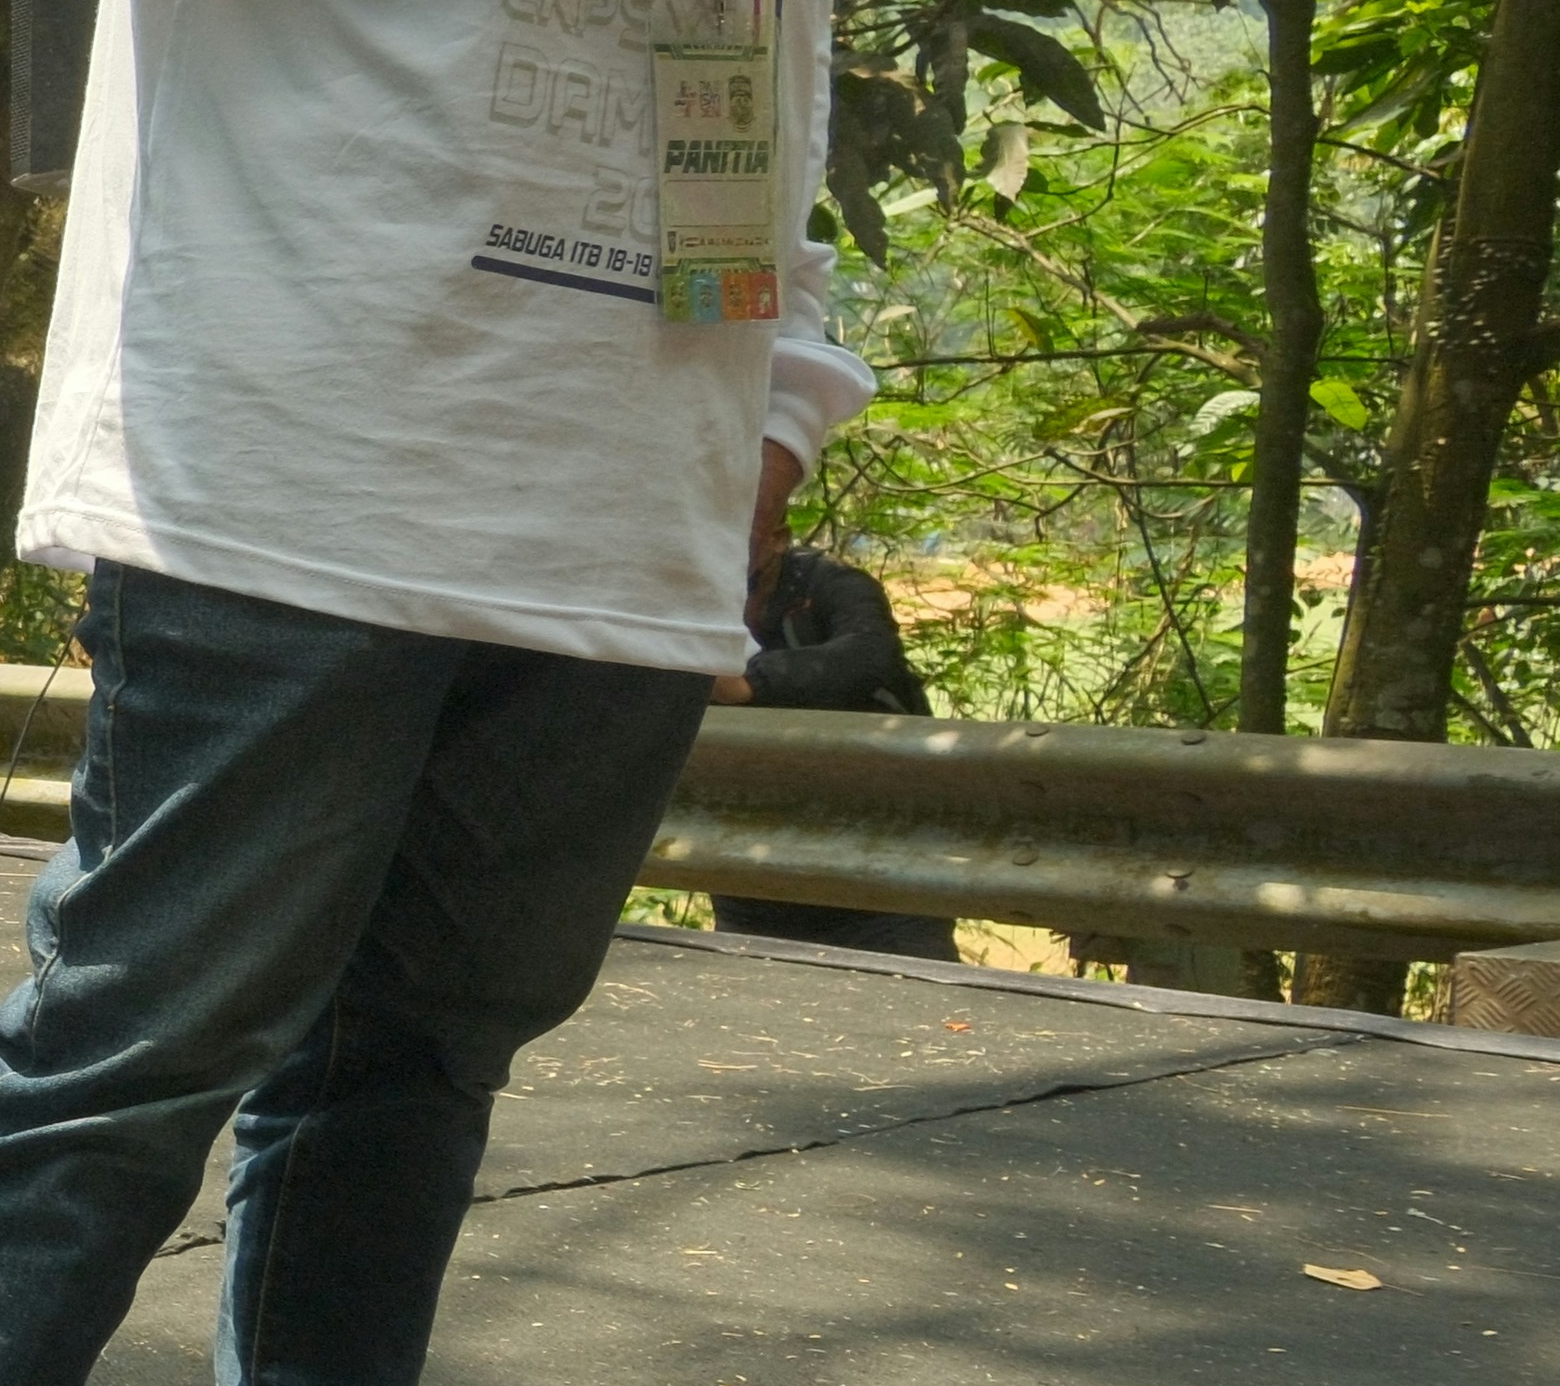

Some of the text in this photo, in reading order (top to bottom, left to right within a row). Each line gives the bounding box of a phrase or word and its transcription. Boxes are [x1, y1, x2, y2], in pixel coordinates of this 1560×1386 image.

[488, 41, 654, 157] DAM
[663, 140, 769, 174] PANITIA
[485, 223, 654, 278] SABUGA ITB 18-19
